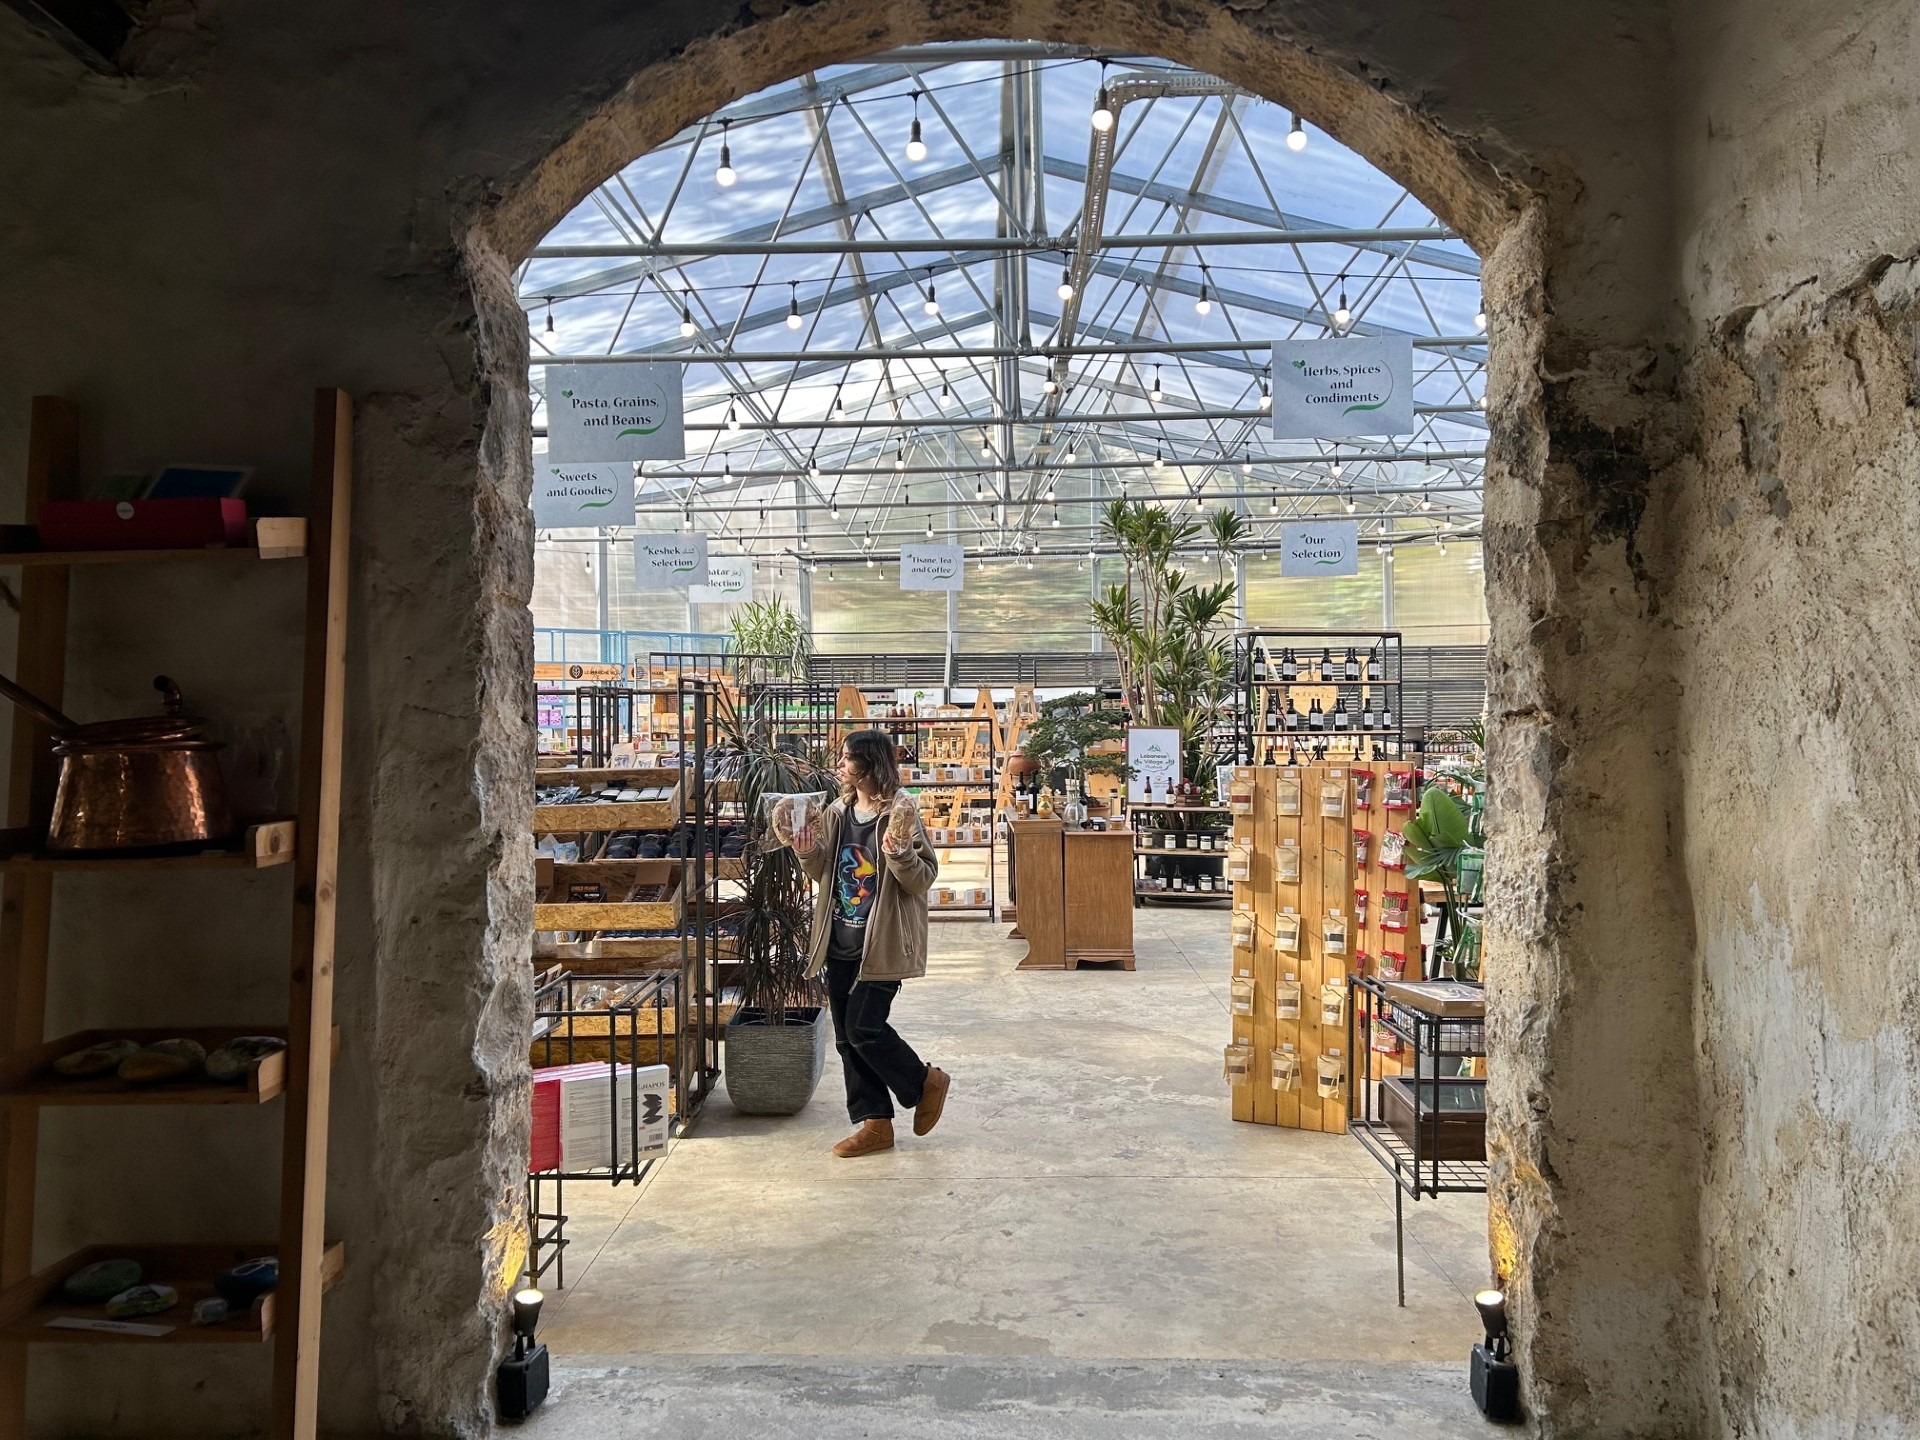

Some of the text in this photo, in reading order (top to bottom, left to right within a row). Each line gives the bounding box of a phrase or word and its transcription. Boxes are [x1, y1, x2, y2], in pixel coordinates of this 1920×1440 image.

[1303, 364, 1381, 377] Herbs, Spices
[1330, 379, 1353, 389] and
[572, 395, 659, 410] Pasta, Grains,
[1305, 392, 1380, 404] Condiments
[583, 414, 652, 427] and Beans
[558, 471, 597, 482] Sweets
[546, 485, 613, 498] and Goodies
[1305, 535, 1326, 545] Our
[648, 546, 681, 555] Keshek
[1291, 548, 1341, 560] Selection
[651, 559, 693, 567] Selection
[940, 556, 952, 564] Tea
